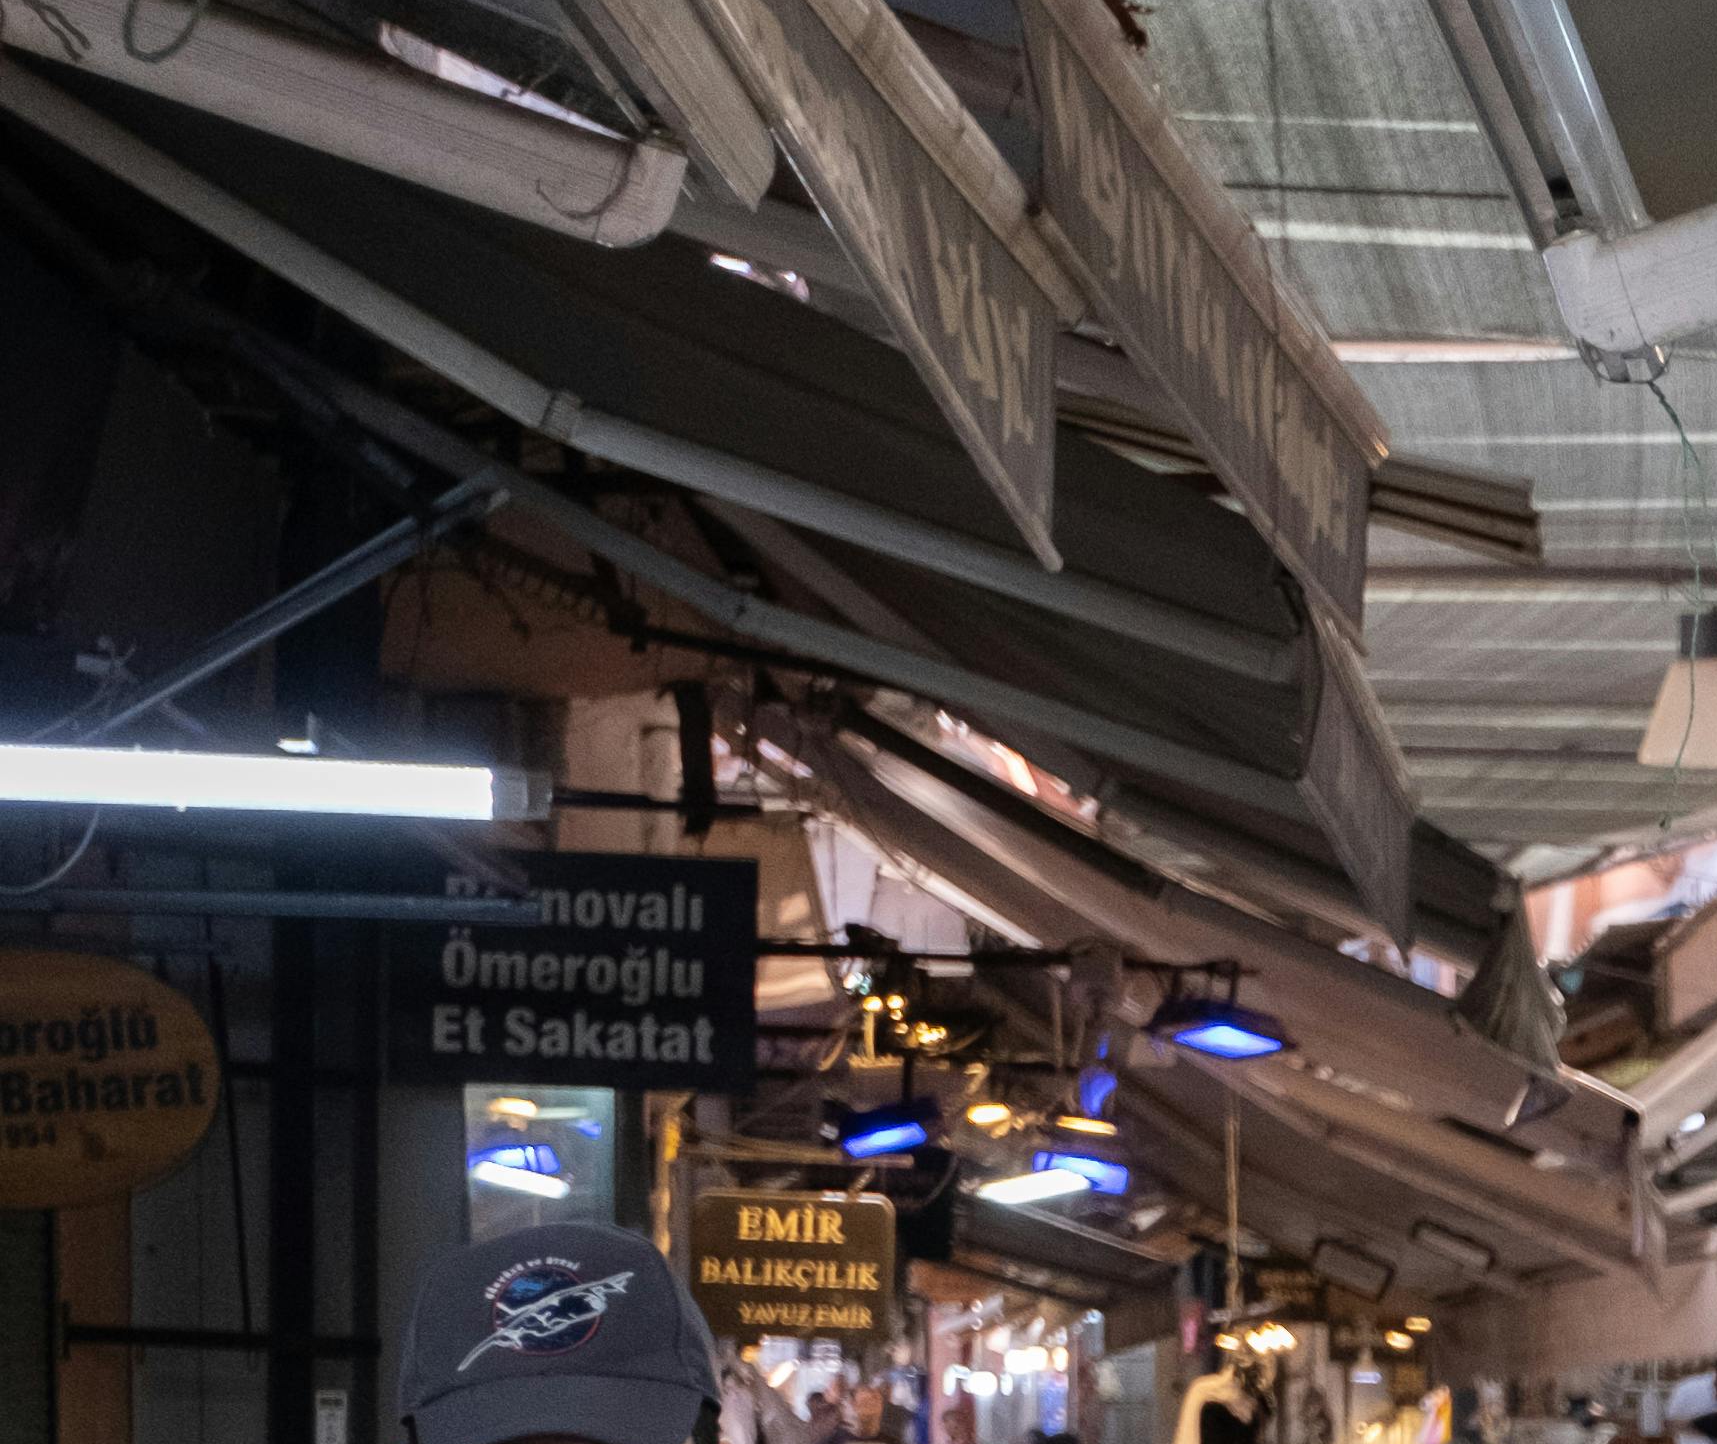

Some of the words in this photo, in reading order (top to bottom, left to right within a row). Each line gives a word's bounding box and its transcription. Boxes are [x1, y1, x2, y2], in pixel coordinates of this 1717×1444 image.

[446, 876, 704, 931] novalı
[442, 927, 704, 1006] Ömeroğlu
[432, 1005, 486, 1054] Et
[504, 1007, 715, 1064] Sakatat
[0, 1061, 207, 1115] Baharat
[737, 1202, 846, 1244] EMİR
[701, 1256, 881, 1293] BALIKÇILIK
